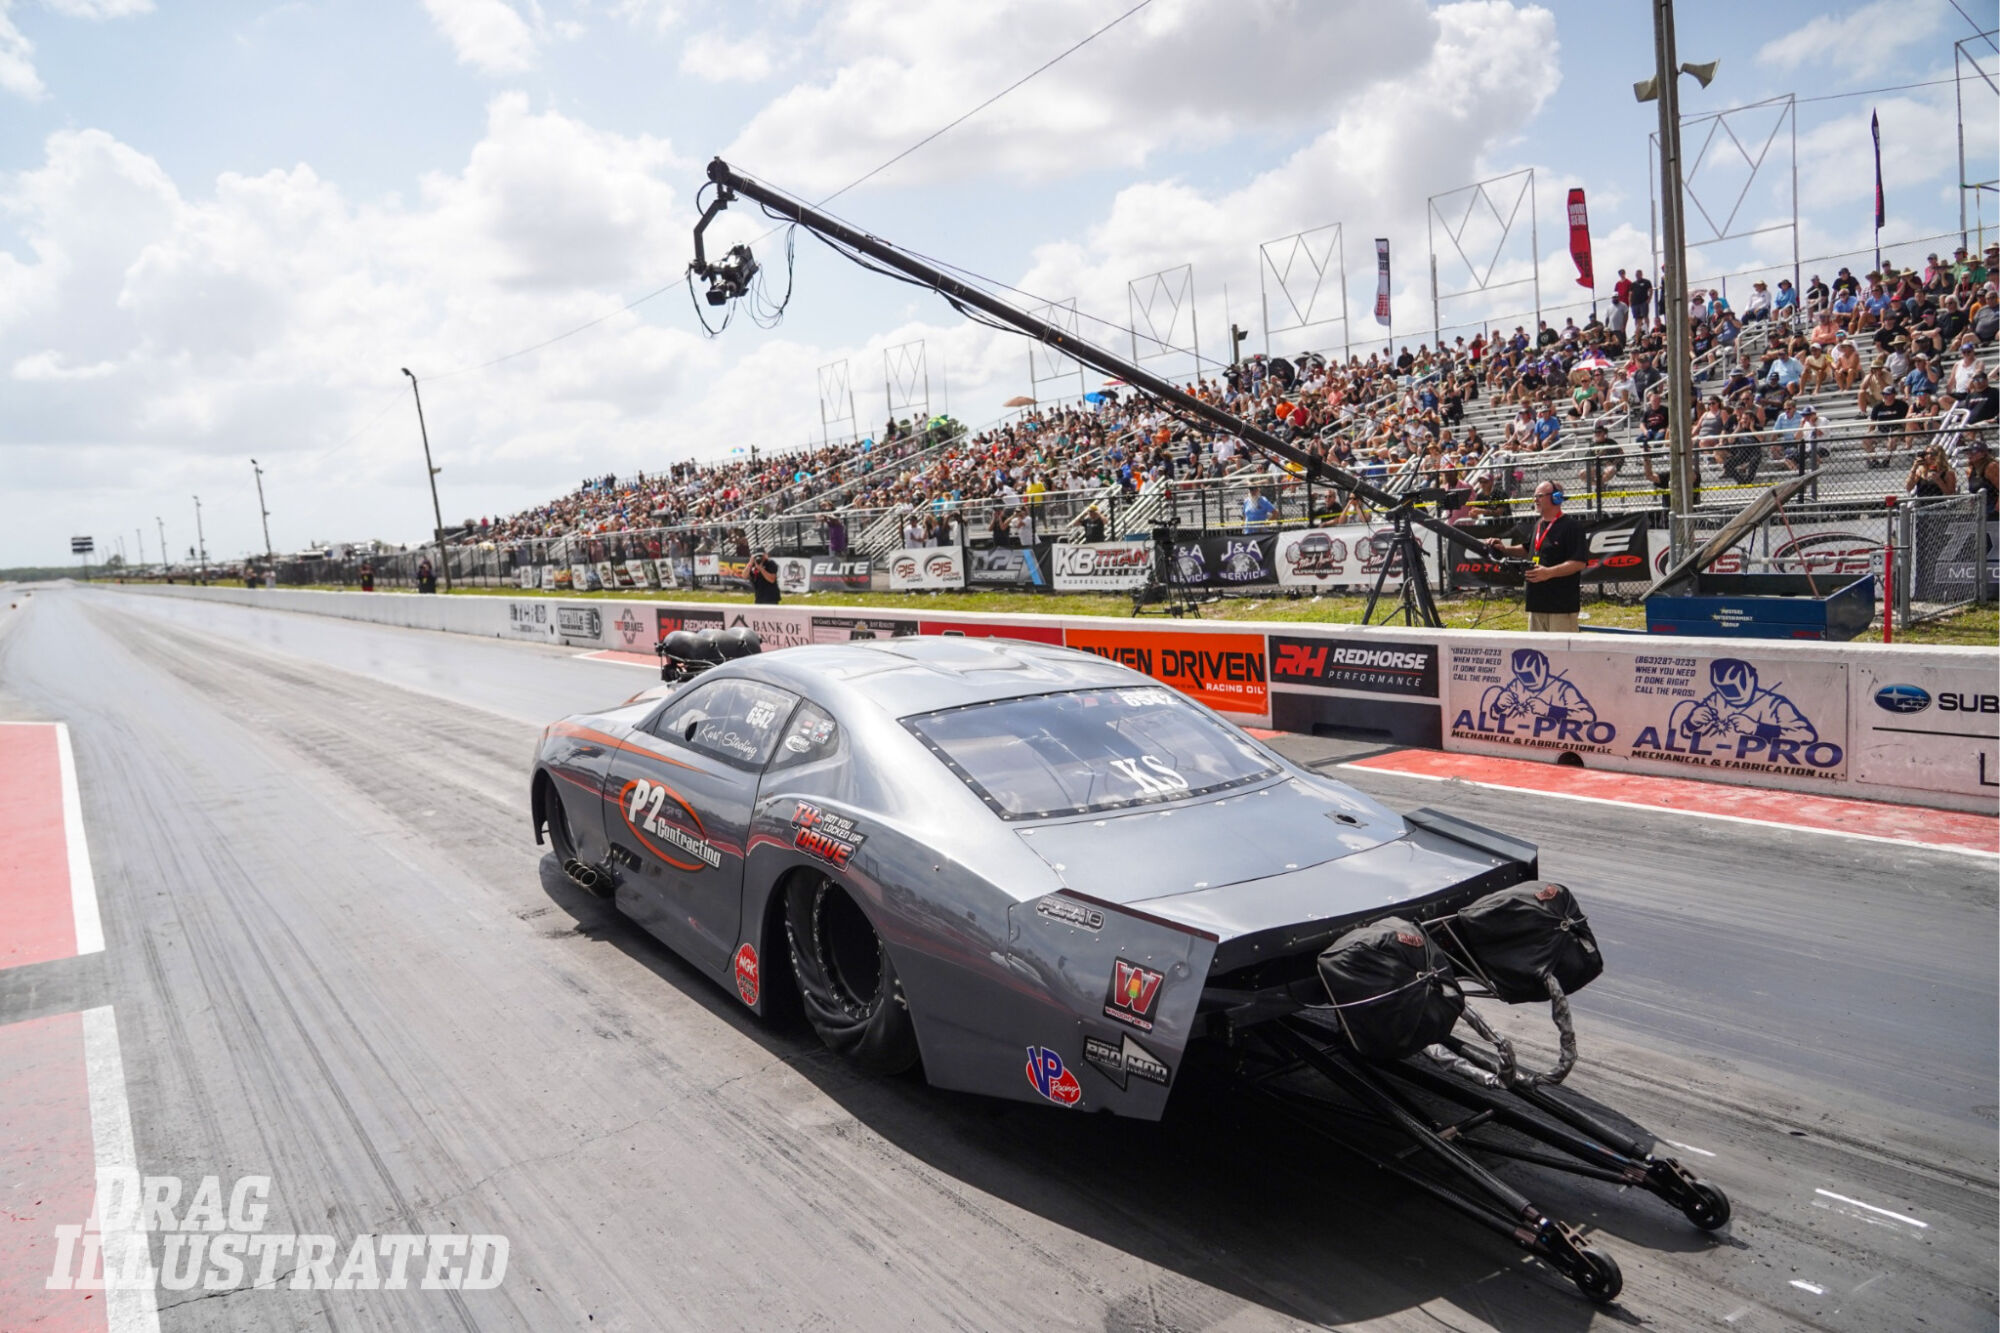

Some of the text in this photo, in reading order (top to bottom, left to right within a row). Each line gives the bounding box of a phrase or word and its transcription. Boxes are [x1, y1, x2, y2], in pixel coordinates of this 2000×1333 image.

[971, 548, 1025, 570] TYPE
[1055, 547, 1150, 576] KB TITAN
[1173, 544, 1206, 563] &A
[1221, 540, 1263, 562] J&A
[1607, 557, 1637, 566] LLC
[813, 561, 870, 575] ELITE
[896, 563, 916, 578] PJS
[930, 561, 953, 577] PJS
[1096, 568, 1146, 576] RACING
[1220, 570, 1267, 581] SERVICE
[684, 619, 724, 632] REDHORSE
[753, 620, 802, 635] BANK OF
[759, 635, 809, 647] NGLAND
[1162, 650, 1265, 689] DRIVEN
[1274, 644, 1329, 678] RH
[1333, 648, 1428, 670] REDHORSE
[1635, 656, 1696, 667] (863)287-0233
[1328, 671, 1422, 687] PERFORMANCE
[1453, 673, 1467, 681] CALL
[1470, 674, 1481, 682] THE
[1635, 666, 1696, 677] WHEN YOU NEED
[1644, 676, 1664, 685] DONE
[1666, 677, 1689, 686] RIGHT
[1206, 683, 1243, 693] RACING
[1246, 685, 1264, 694] OIL
[1635, 685, 1696, 697] CALL THE PROS!
[1938, 692, 1999, 714] SUB
[746, 706, 775, 729] 6542
[1452, 709, 1616, 744] ALL-PRO
[1451, 729, 1511, 744] MECHANICAL
[1524, 739, 1596, 753] FABRICATION
[1632, 726, 1843, 768] ALL-PRO
[1109, 755, 1189, 794] KS
[1631, 750, 1837, 780] MECHANICAL & FABRICATION LLC
[628, 778, 666, 834] P2
[824, 813, 853, 830] GOT YOU
[657, 816, 722, 868] Contracting
[823, 823, 864, 845] LOCKED UP!
[796, 827, 853, 865] DRIVE
[739, 956, 757, 977] NGK
[1086, 1043, 1122, 1065] PRO
[1026, 1046, 1064, 1099] VP
[1127, 1056, 1168, 1078] MOD
[1051, 1080, 1080, 1098] Racing
